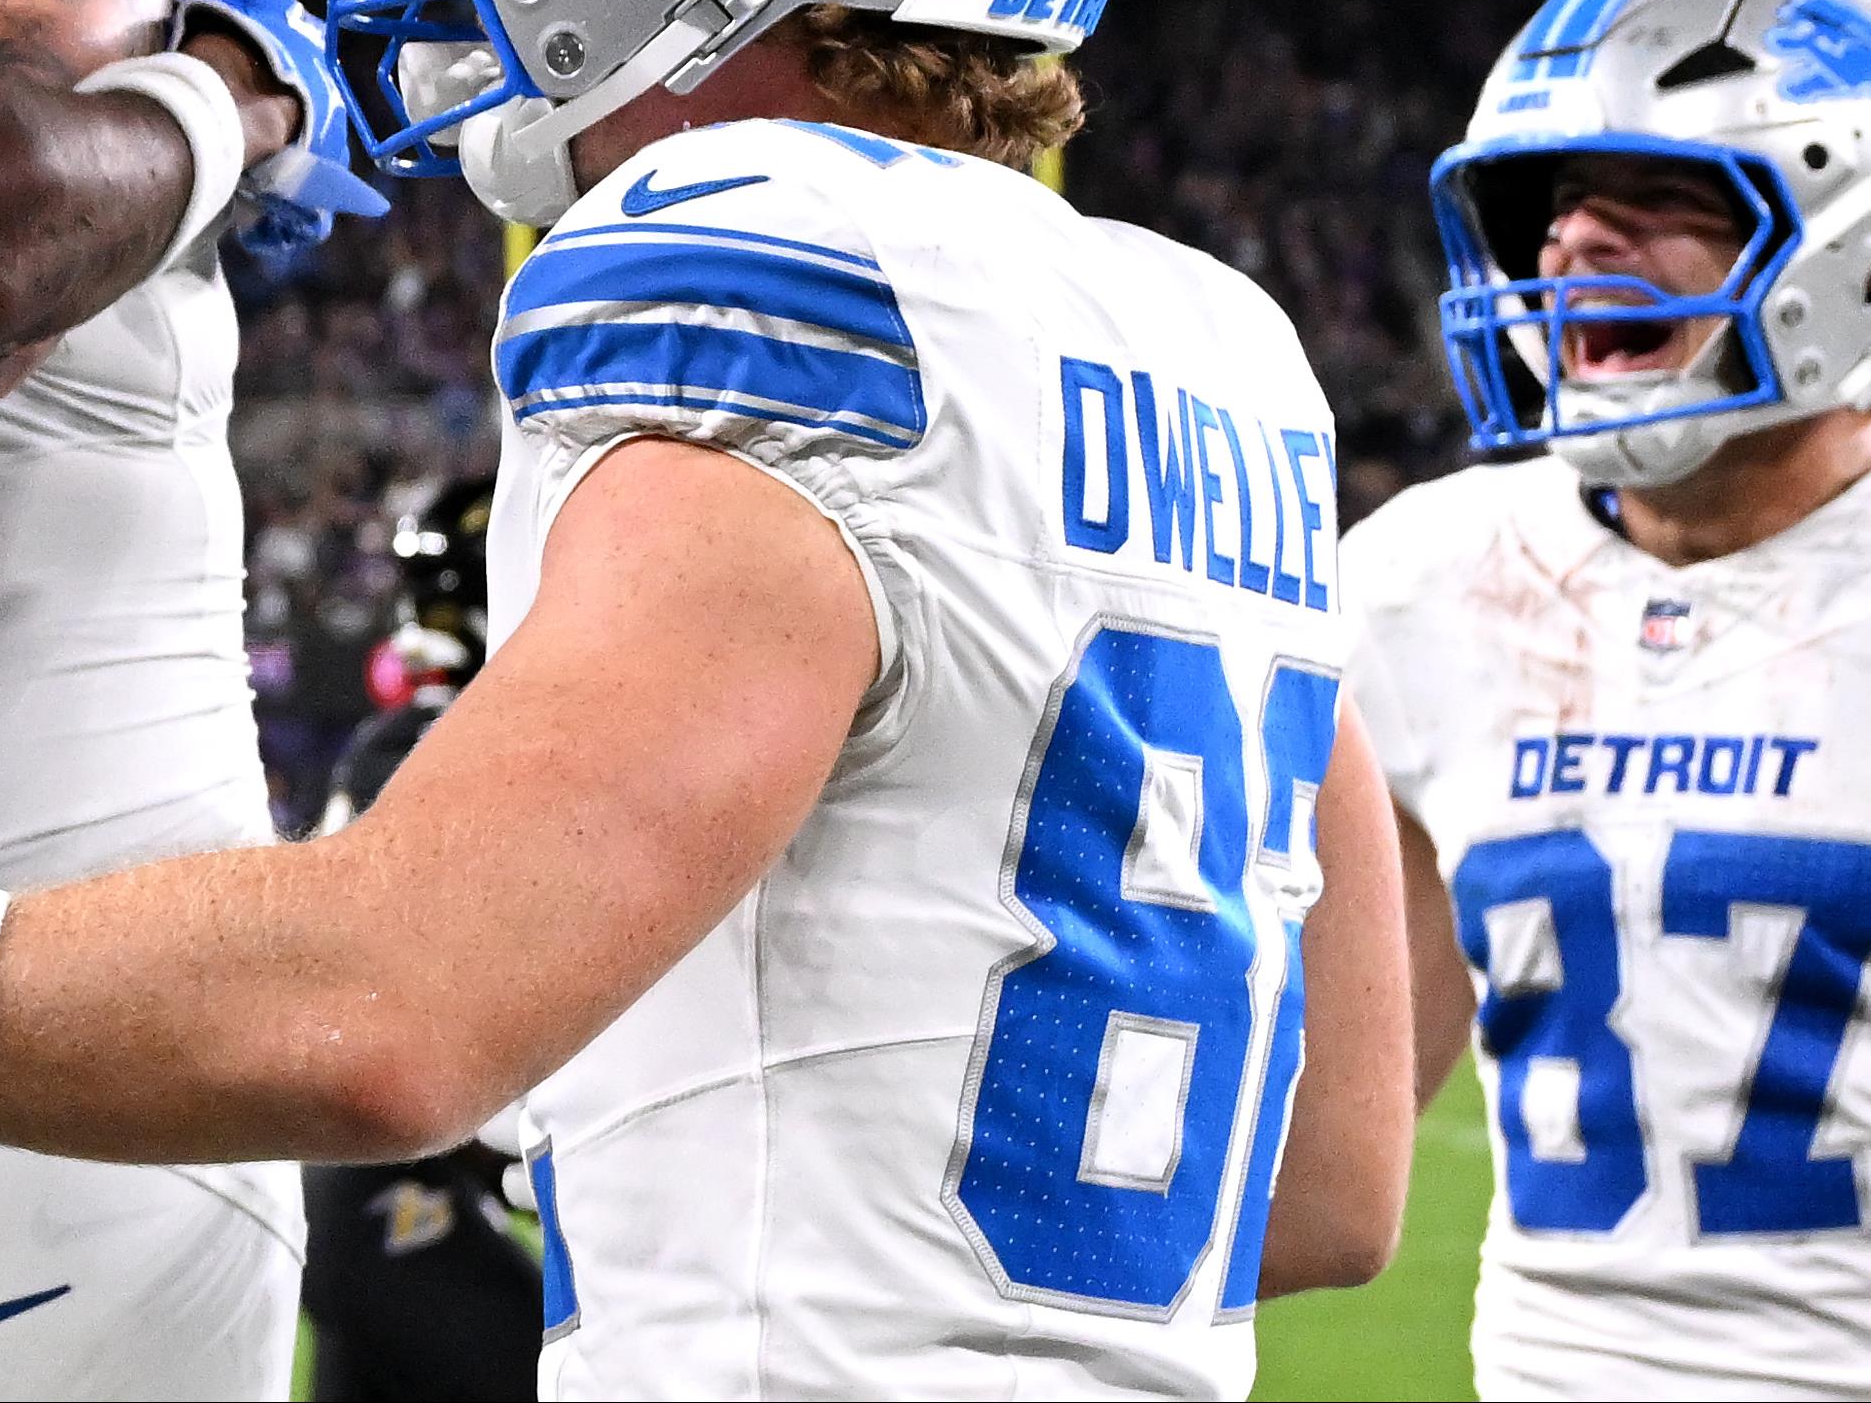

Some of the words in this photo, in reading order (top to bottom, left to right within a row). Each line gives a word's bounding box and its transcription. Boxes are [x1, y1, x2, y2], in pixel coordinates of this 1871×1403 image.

[1058, 354, 1338, 615] DWELLE
[1508, 733, 1820, 799] DETROIT
[1452, 825, 1871, 1244] 87
